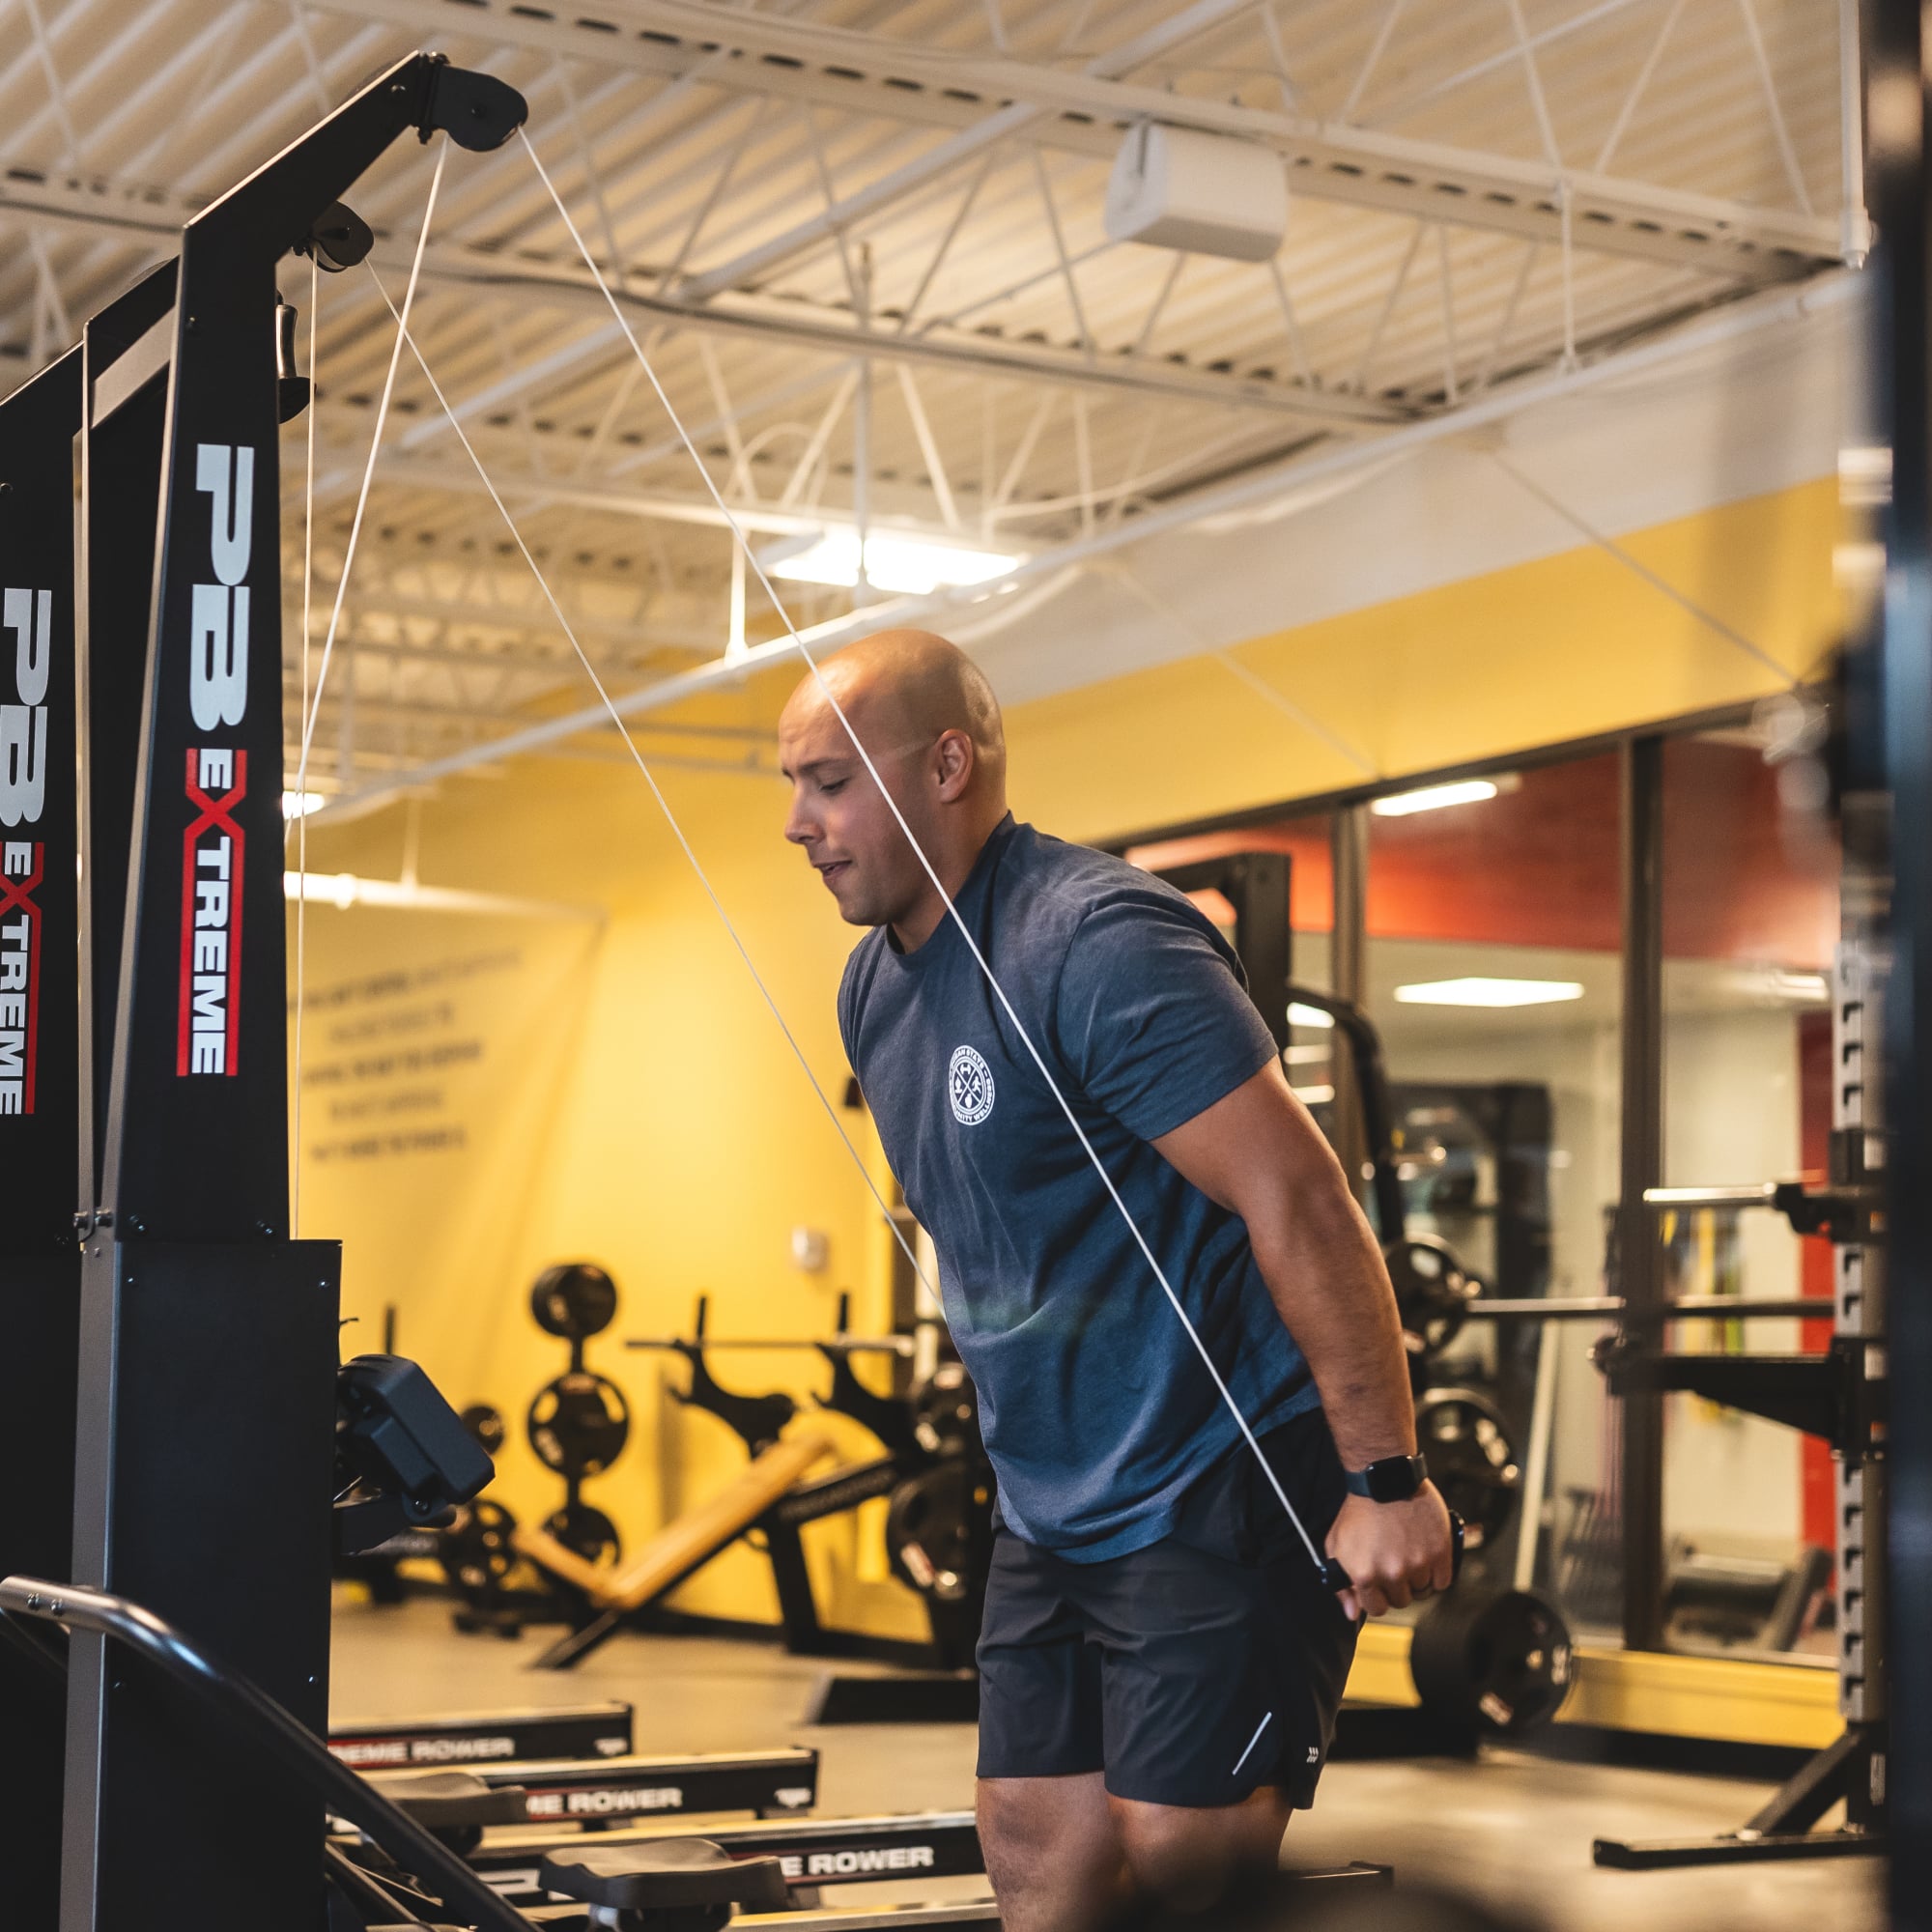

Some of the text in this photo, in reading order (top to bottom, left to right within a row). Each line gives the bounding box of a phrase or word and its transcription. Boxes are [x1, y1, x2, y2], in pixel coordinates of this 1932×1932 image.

[177, 443, 254, 1076] PB EXTREME
[0, 588, 52, 1114] PB EXTREME
[411, 1738, 515, 1760] ROWER
[567, 1787, 683, 1812] ROWER
[809, 1846, 934, 1875] ROWER
